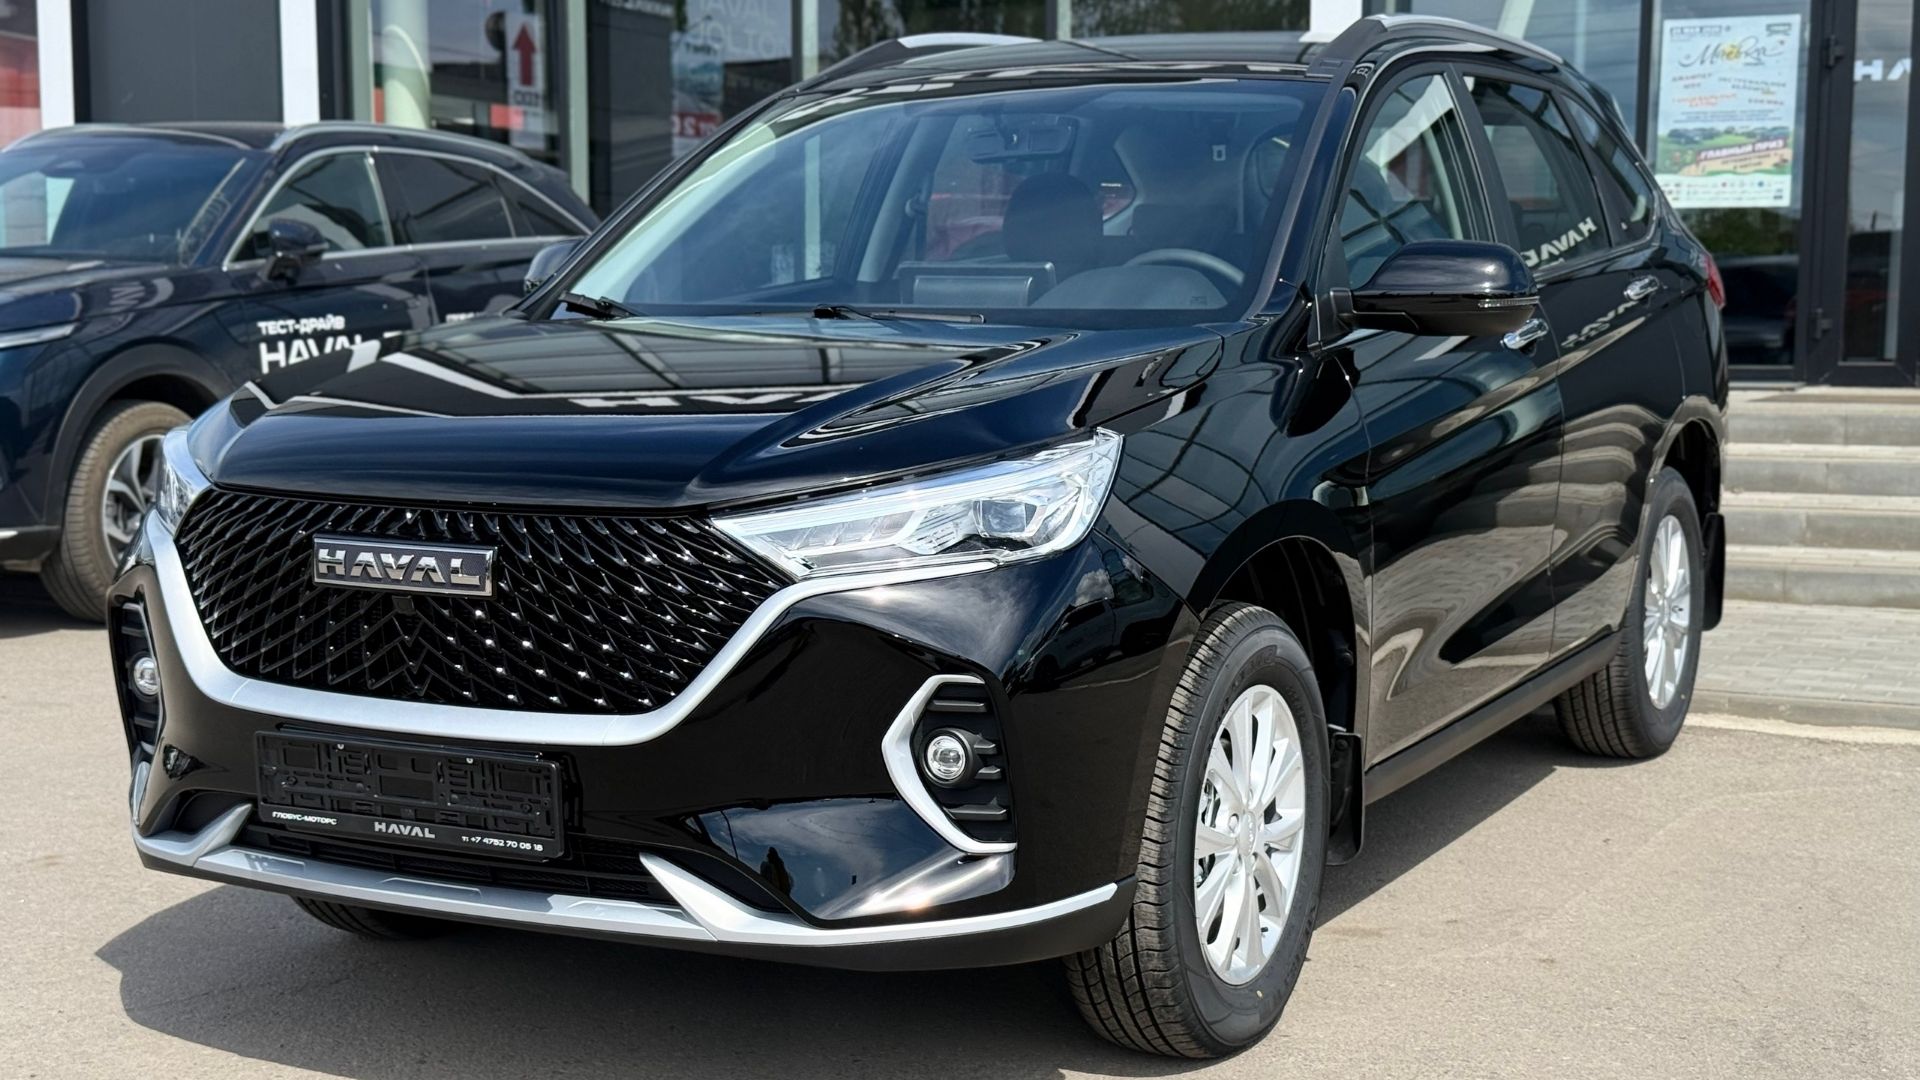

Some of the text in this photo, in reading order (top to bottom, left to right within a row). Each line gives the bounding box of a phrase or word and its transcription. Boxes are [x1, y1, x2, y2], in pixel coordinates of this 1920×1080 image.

[256, 313, 346, 335] ТЕСТ-ДРАЙВ
[318, 548, 481, 586] HAVAL
[272, 811, 338, 825] ГЛОБУС-МОТОРС
[374, 821, 436, 839] HAVAL
[470, 836, 482, 844] +7
[482, 837, 505, 847] 4752
[506, 840, 518, 849] 70
